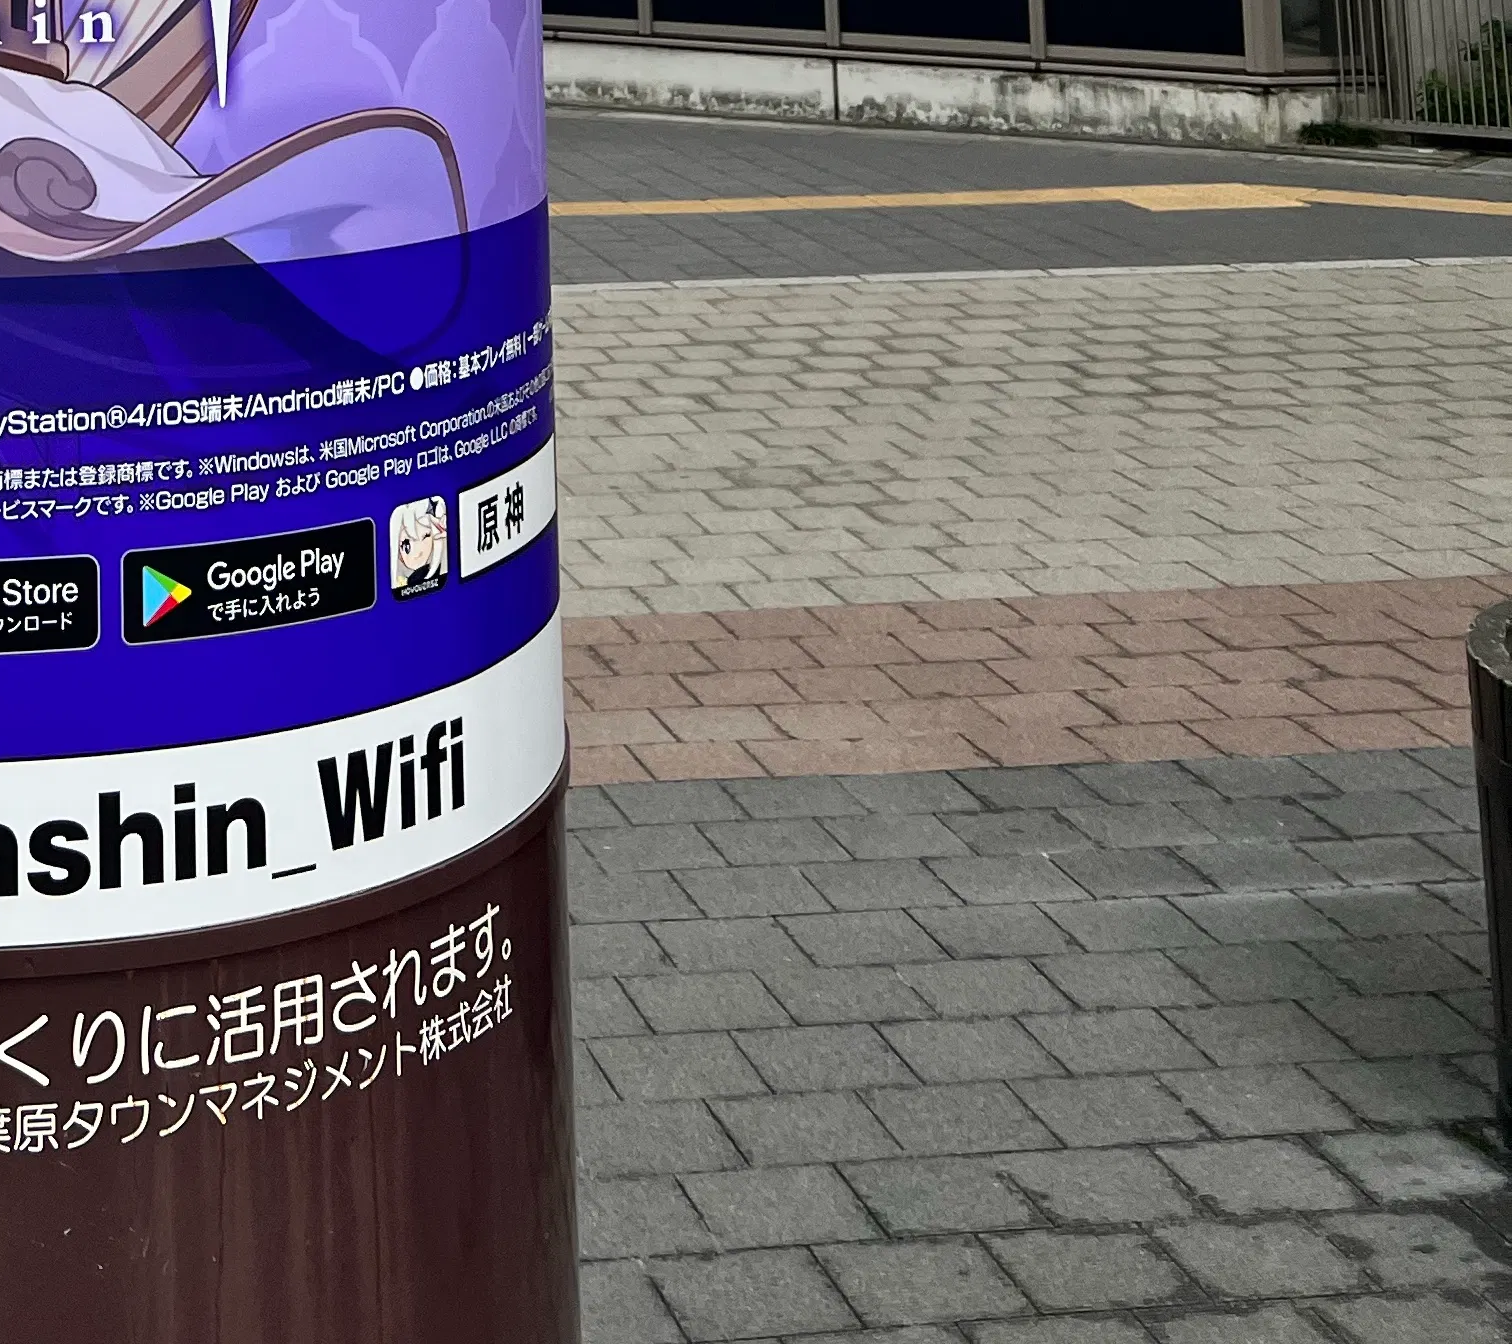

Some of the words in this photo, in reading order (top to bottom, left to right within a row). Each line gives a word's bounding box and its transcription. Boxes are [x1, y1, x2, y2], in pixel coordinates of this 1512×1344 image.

[230, 482, 270, 503] Play
[275, 472, 321, 498] および
[325, 462, 380, 490] Google
[383, 457, 413, 476] Play
[490, 421, 508, 445] LLC
[477, 480, 525, 554] 原神
[206, 559, 294, 593] Google
[299, 547, 345, 580] Play
[2, 580, 79, 607] Store
[206, 587, 321, 622] で手に入れよう
